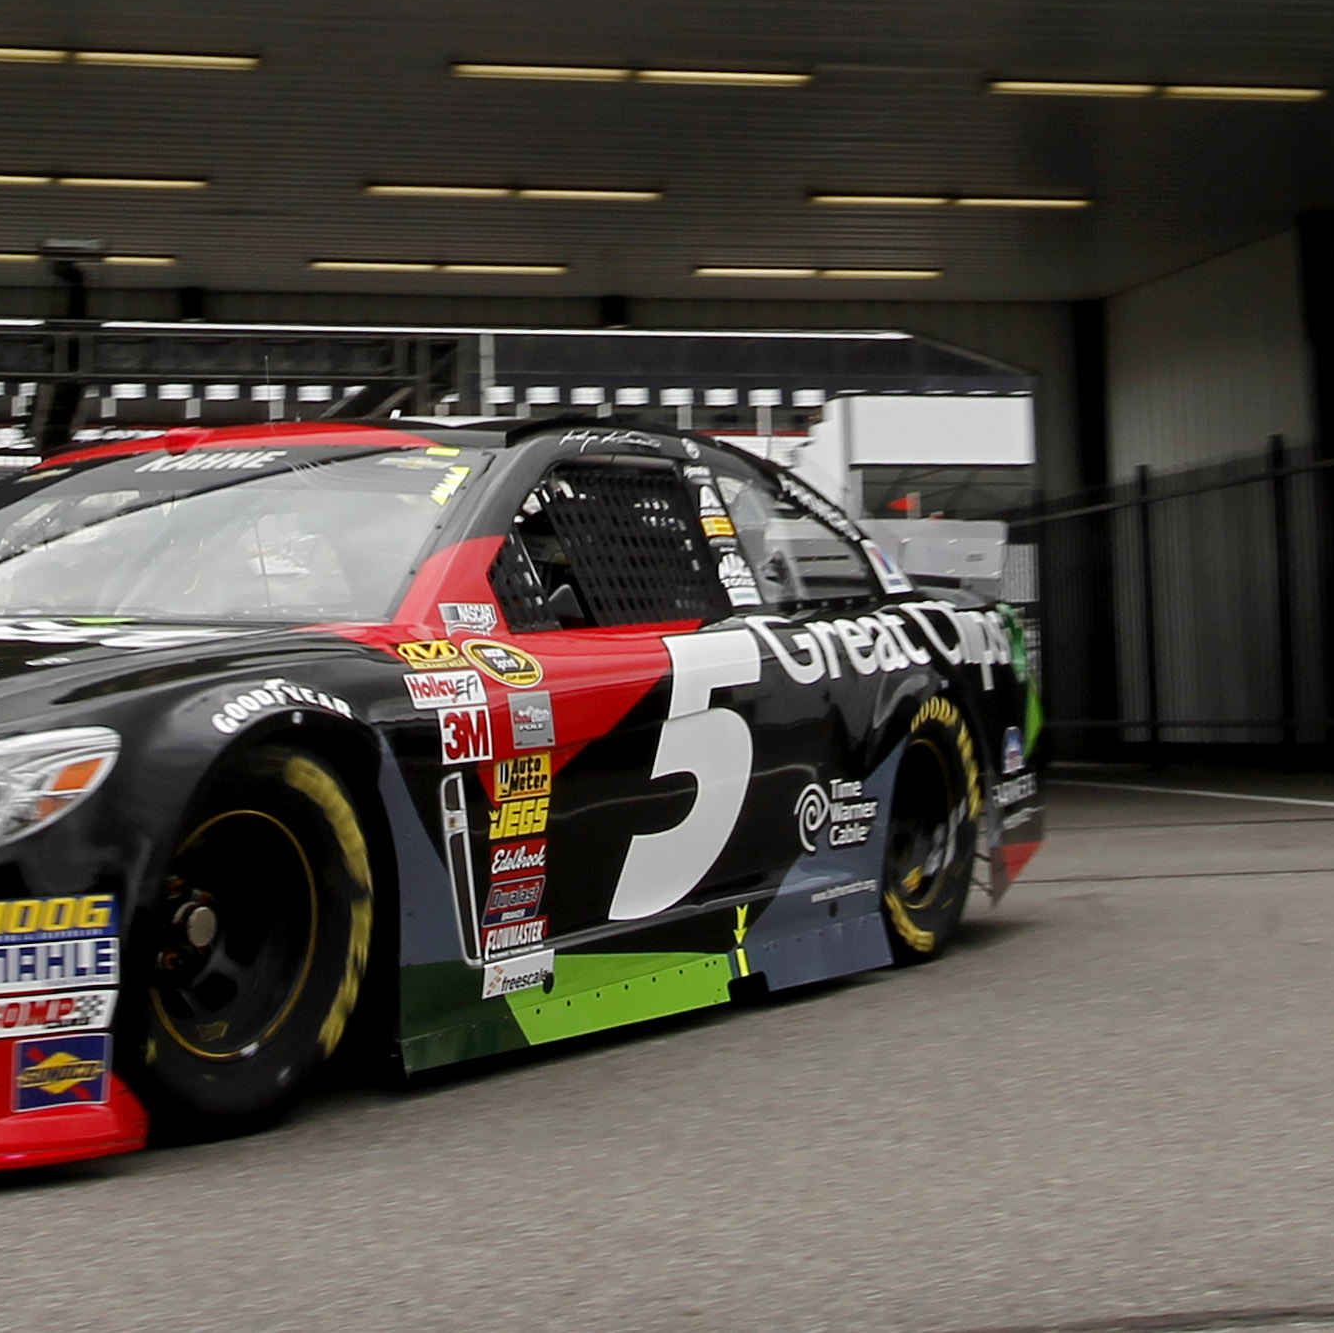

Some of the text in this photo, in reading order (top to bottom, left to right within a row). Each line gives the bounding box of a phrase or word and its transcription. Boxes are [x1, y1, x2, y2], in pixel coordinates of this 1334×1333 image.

[745, 611, 932, 684] Great
[408, 675, 457, 704] Holley
[211, 679, 354, 734] GOODYEAR
[443, 709, 490, 761] 3M
[511, 756, 542, 775] Auto
[608, 629, 761, 921] 5
[510, 773, 548, 793] Meter
[829, 778, 863, 800] Time
[489, 797, 550, 840] JEGS
[829, 801, 878, 823] Warner
[829, 823, 869, 846] Cable
[491, 845, 546, 874] Edelbrock
[490, 881, 540, 911] Duralast
[485, 920, 545, 960] FLOWMASTER
